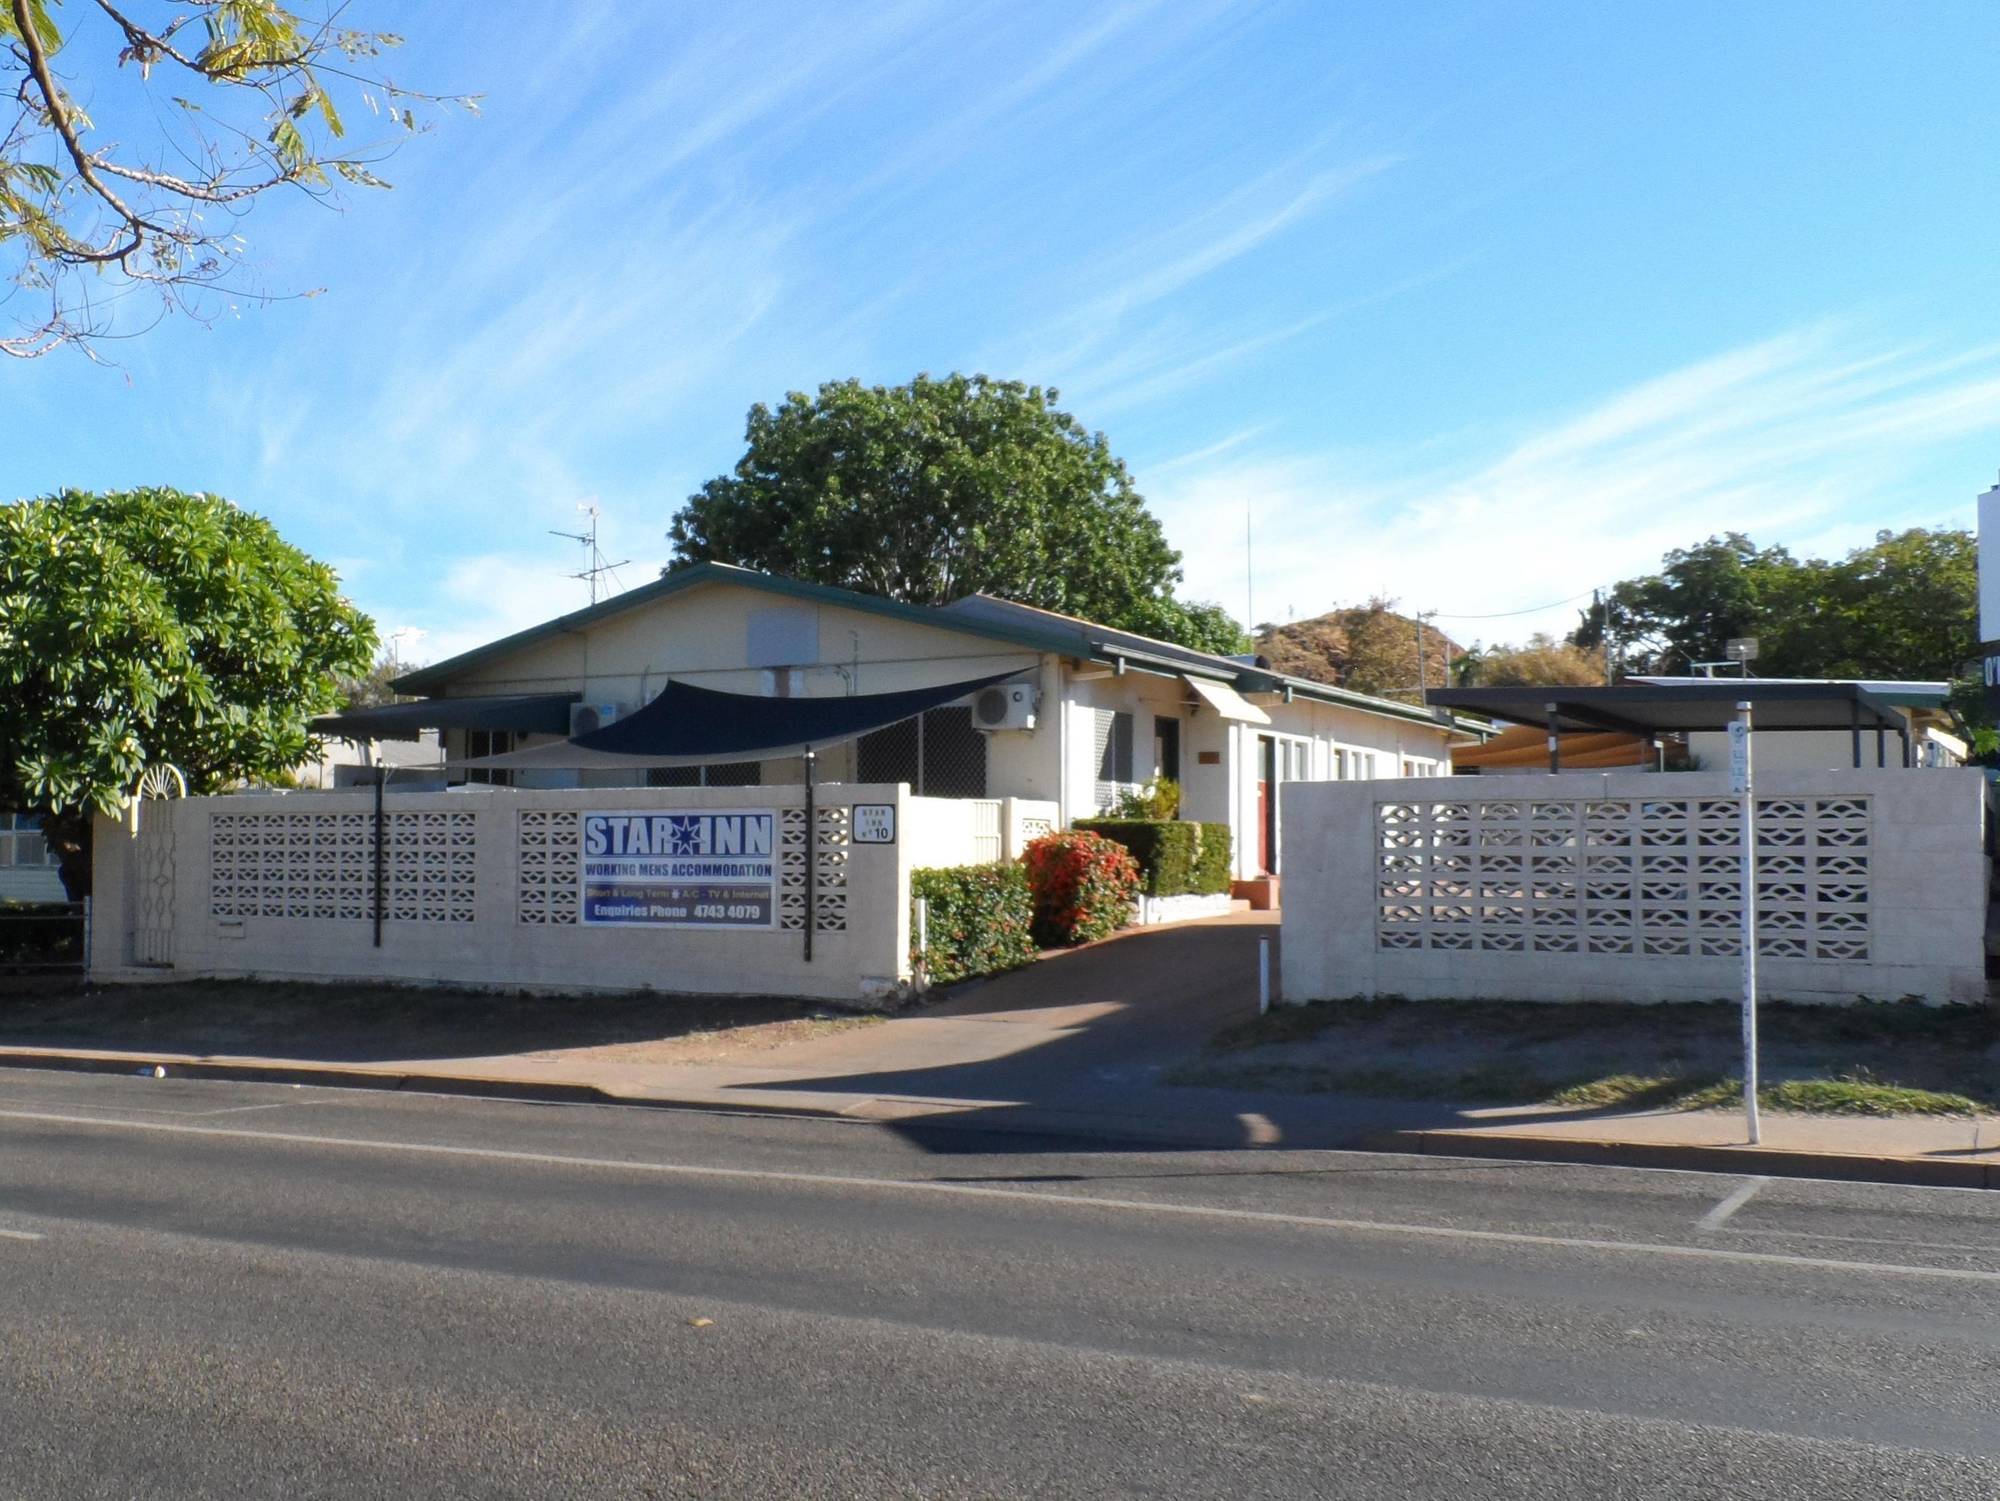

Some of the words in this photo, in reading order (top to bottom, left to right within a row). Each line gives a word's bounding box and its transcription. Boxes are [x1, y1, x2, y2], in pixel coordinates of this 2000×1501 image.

[586, 817, 673, 855] STAR
[700, 816, 771, 855] INN
[875, 827, 888, 839] 10
[586, 863, 636, 877] WORKING
[639, 863, 669, 877] MENS
[671, 863, 772, 877] ACCOMMODATION
[594, 904, 648, 917] Enquiries
[650, 904, 687, 917] Phone
[694, 904, 725, 918] 4743
[727, 905, 760, 919] 4079
